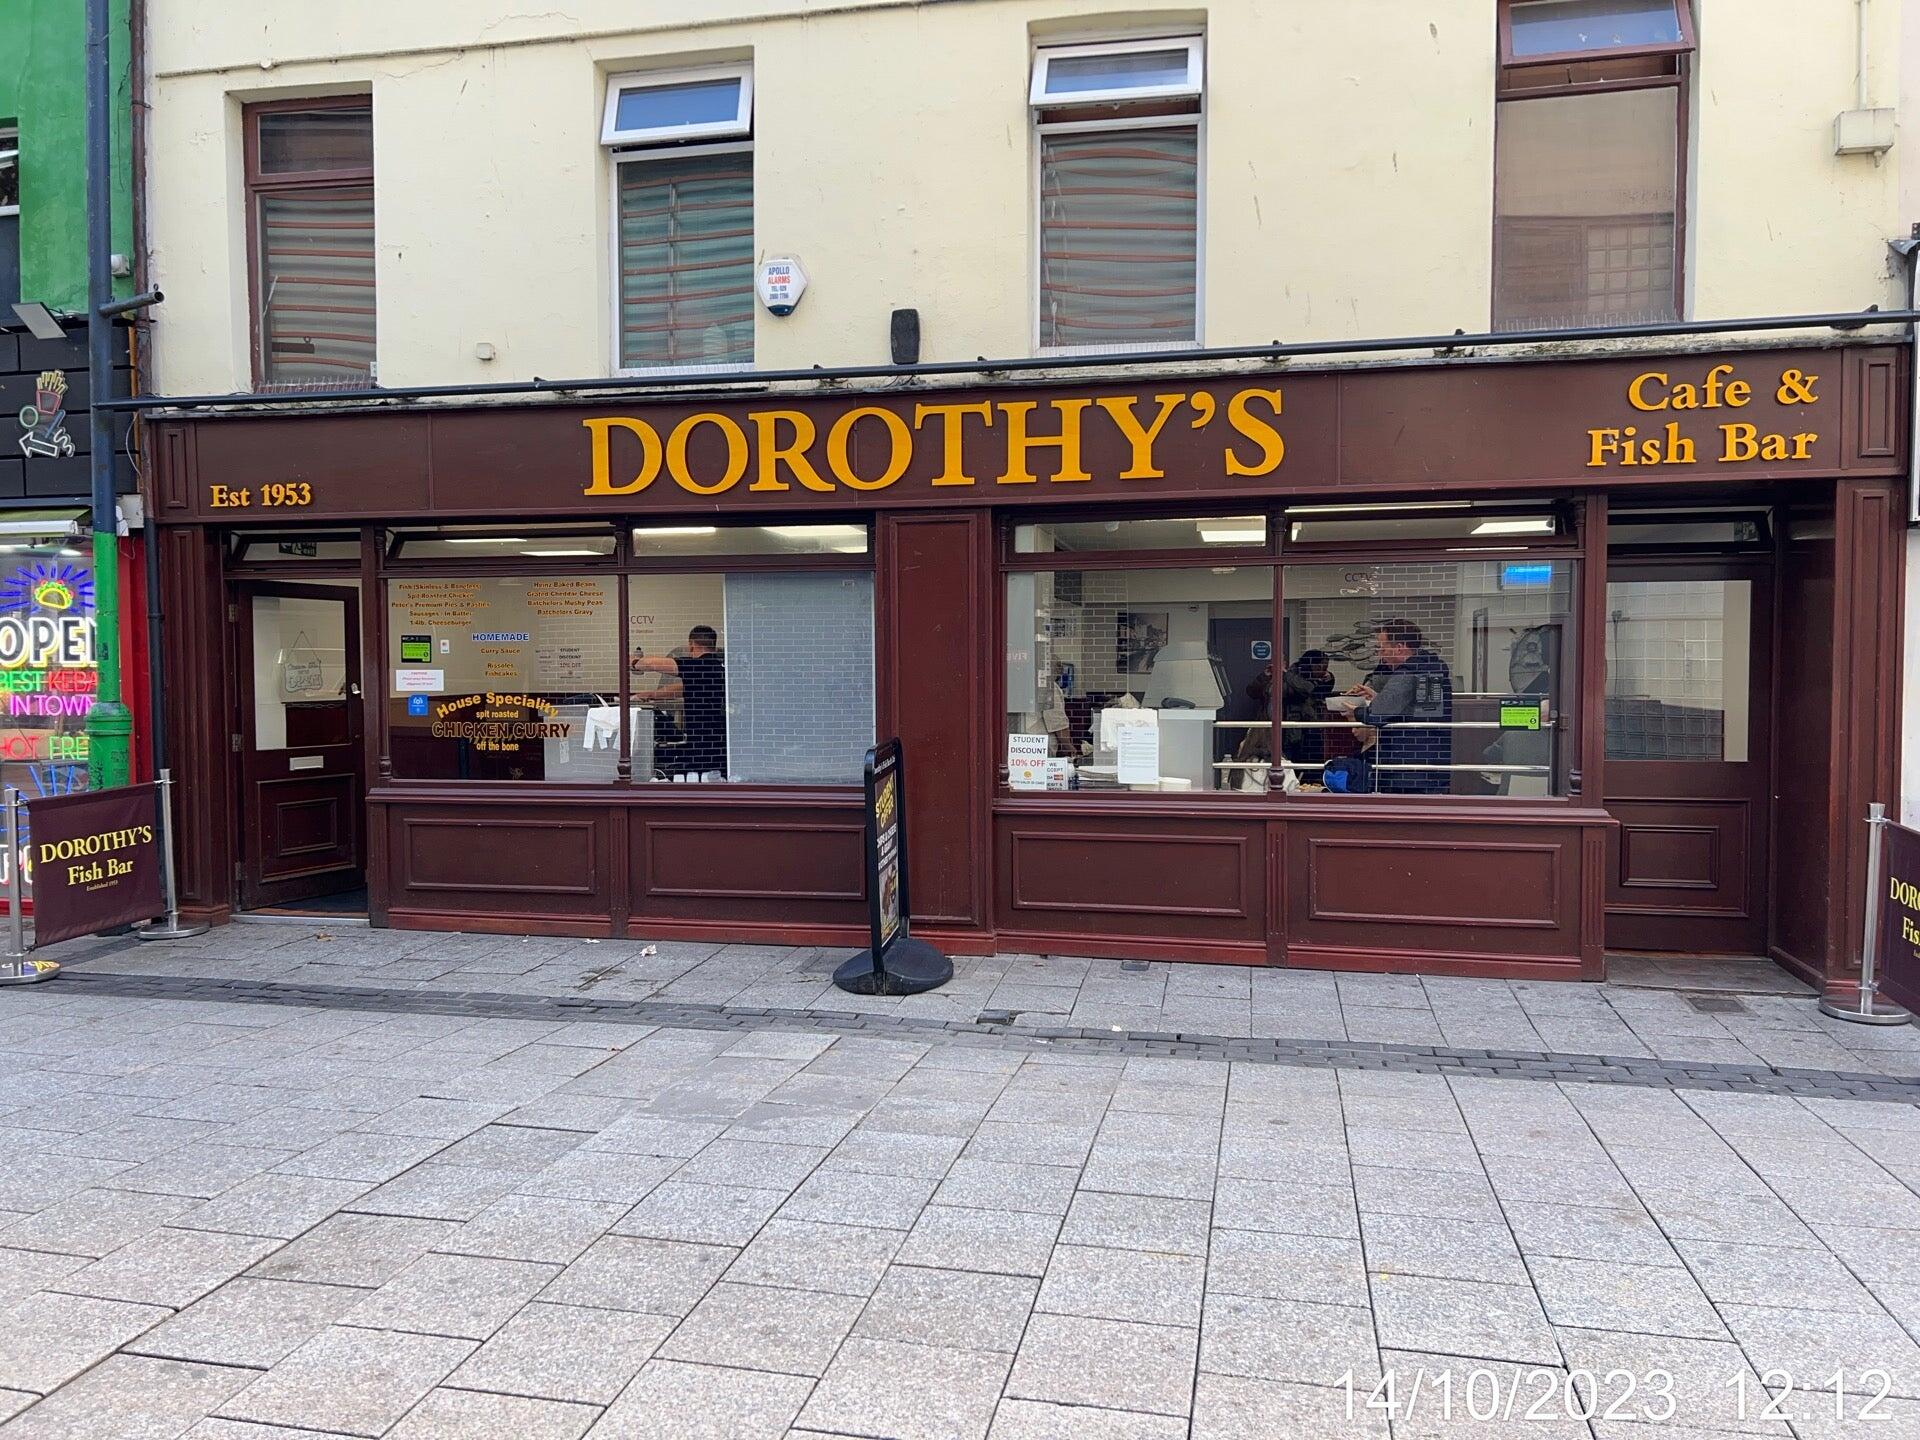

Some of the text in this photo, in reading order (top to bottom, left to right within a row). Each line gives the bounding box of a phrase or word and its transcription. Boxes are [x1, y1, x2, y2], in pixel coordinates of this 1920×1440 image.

[767, 276, 791, 285] ALARMS
[768, 266, 790, 275] APOLLO
[1628, 364, 1819, 411] Cafe &
[582, 388, 1286, 497] DOROTHY'S
[1586, 421, 1819, 467] Fish Bar
[210, 483, 311, 507] Est 1953
[630, 615, 655, 624] CCTV
[472, 633, 529, 641] HOMEMADE
[10, 695, 31, 716] IN
[436, 691, 559, 719] House Speciality
[476, 710, 519, 719] spit roasted
[432, 722, 571, 738] CHICKEN CURRY
[476, 742, 520, 751] off the bone
[1011, 759, 1028, 767] 10%
[40, 825, 152, 864] DOROTHY'S
[67, 858, 134, 886] Fish Bar
[1902, 916, 1920, 946] Fis
